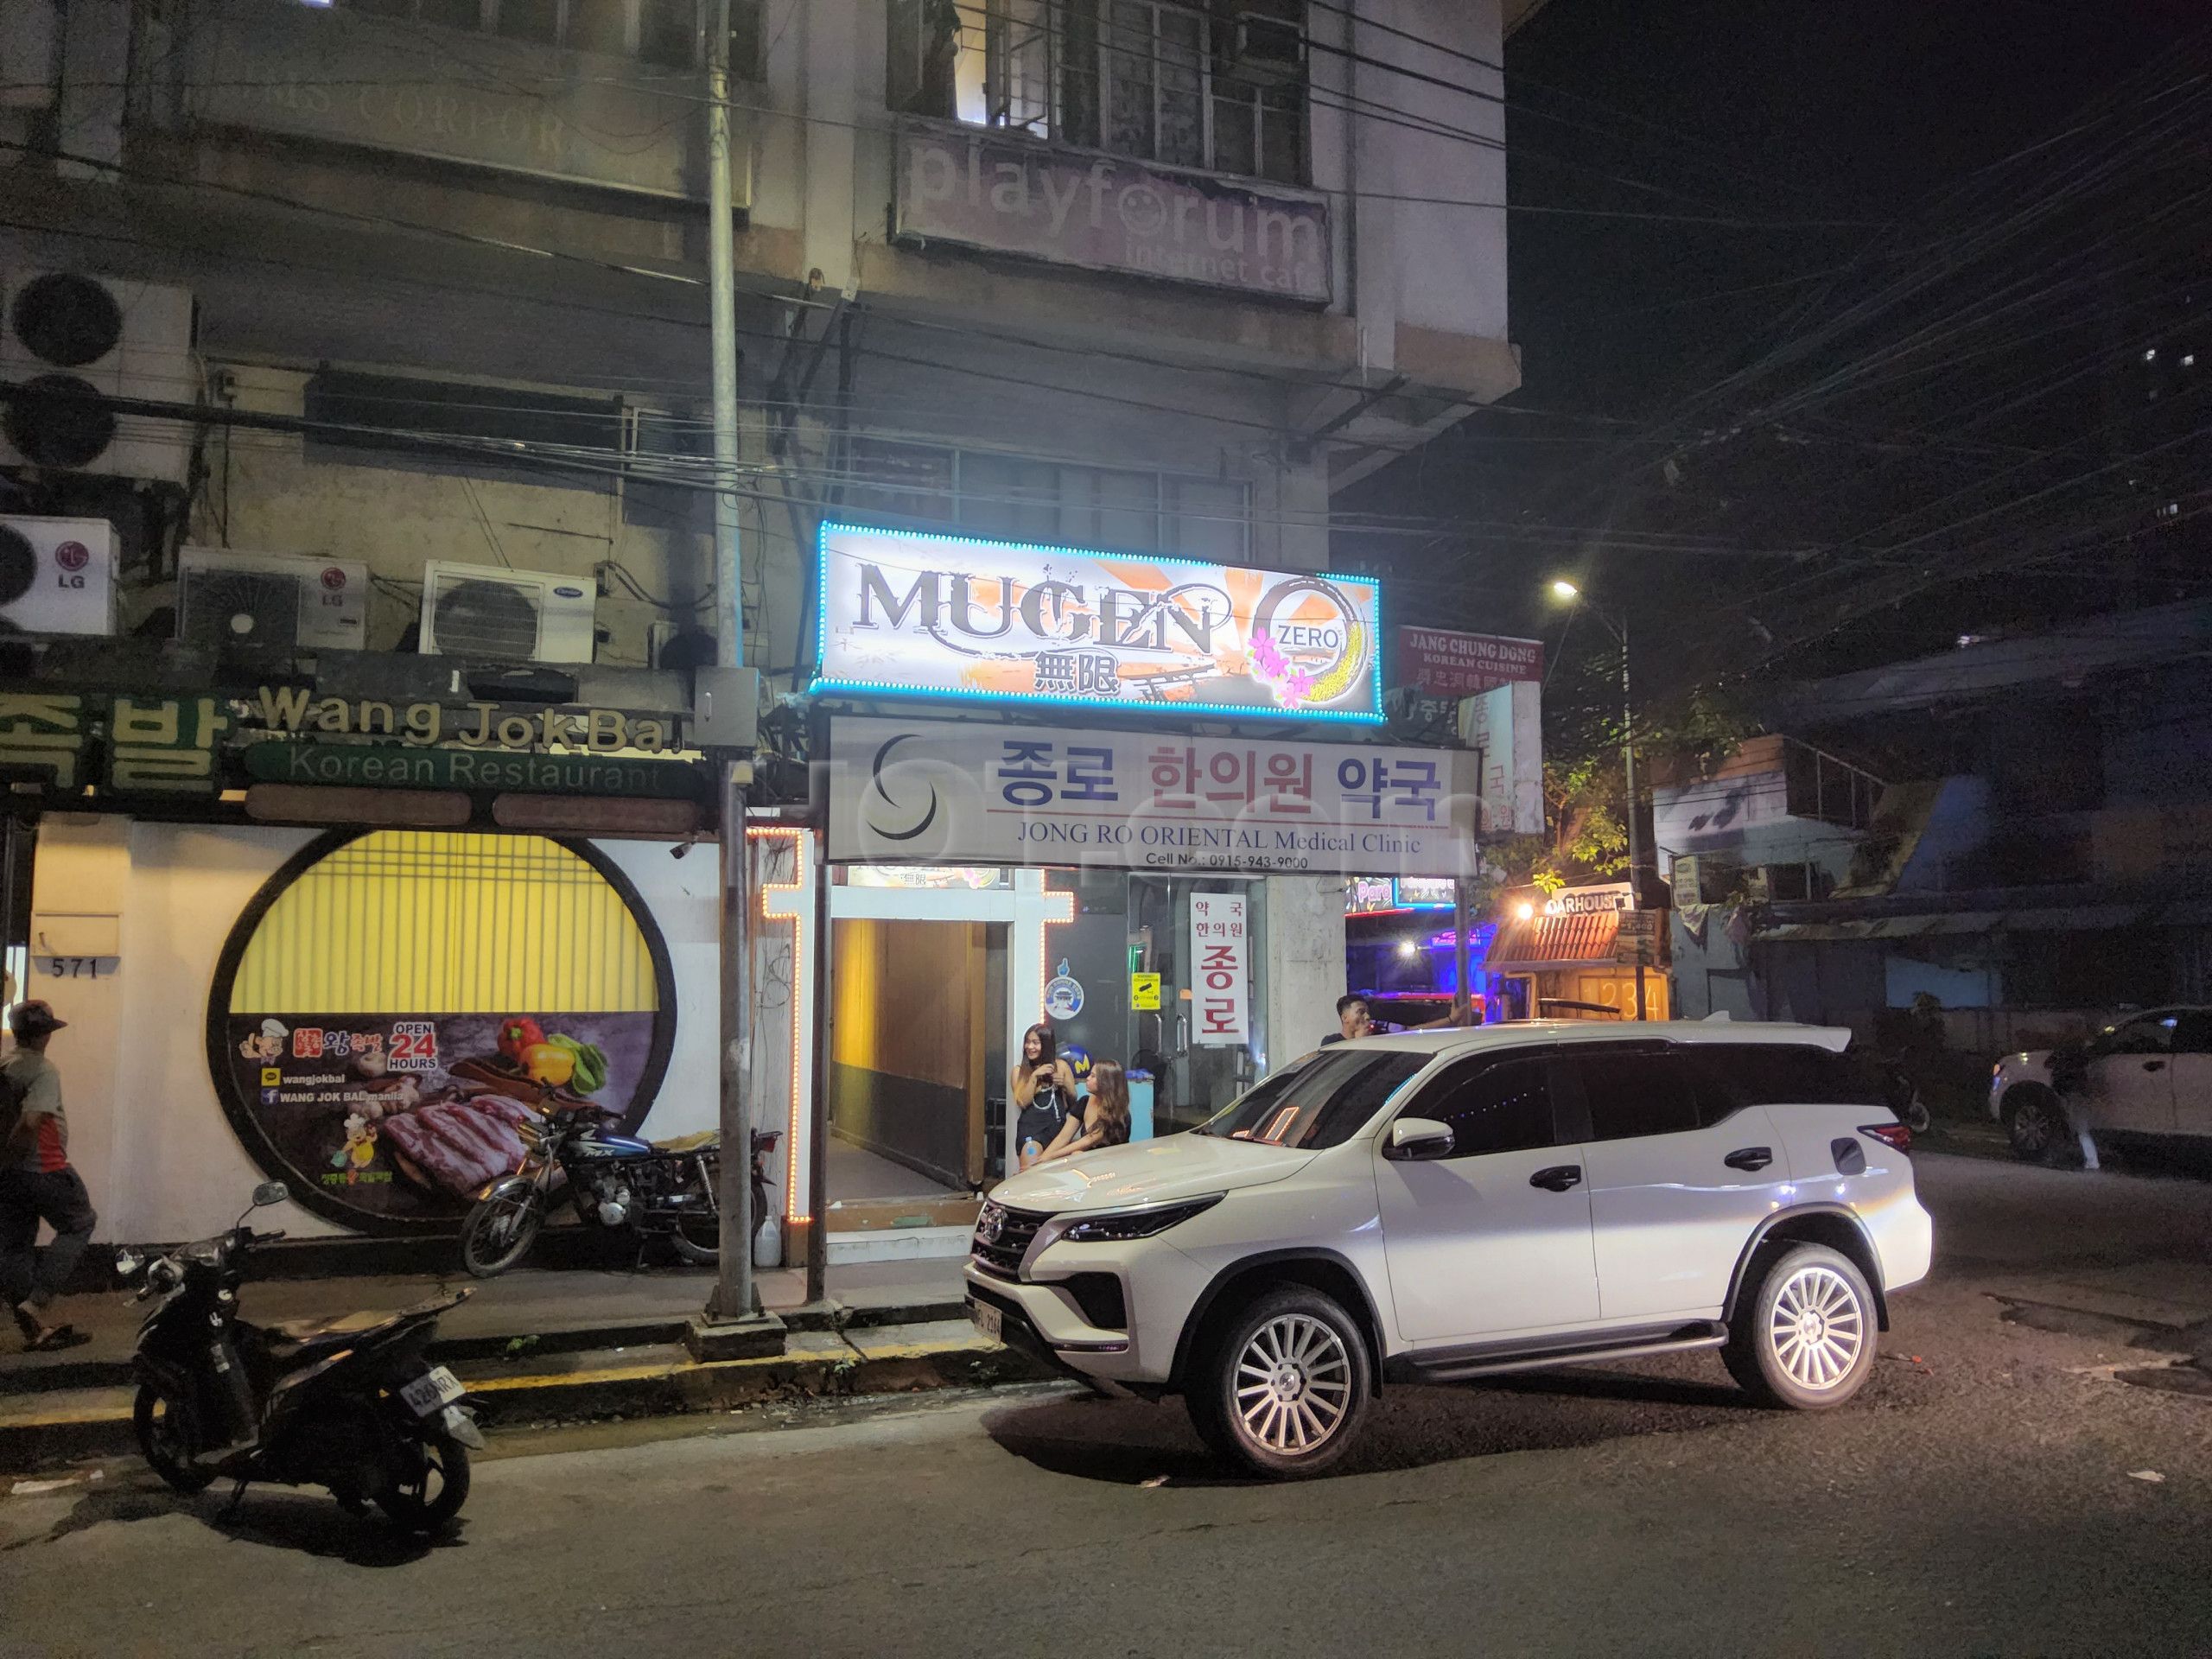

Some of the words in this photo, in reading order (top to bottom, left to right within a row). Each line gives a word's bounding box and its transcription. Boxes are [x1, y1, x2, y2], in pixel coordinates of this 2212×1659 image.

[1125, 234, 1247, 283] internet
[58, 574, 85, 589] LG
[322, 594, 343, 607] LG
[855, 562, 1233, 658] MUGEN
[1278, 624, 1340, 649] ZERO
[1409, 633, 1446, 652] JANG
[1450, 638, 1497, 659] CHUNG
[1499, 646, 1536, 664] DONG
[1033, 652, 1121, 694] 無限
[1424, 653, 1474, 671] KOREAN
[1478, 659, 1527, 675] CUISINE
[259, 685, 442, 745] Wang
[290, 745, 434, 780] Korean
[449, 753, 659, 788] Restaurant
[997, 741, 1119, 807] 종로
[1148, 747, 1313, 813] 한의원
[1338, 757, 1442, 821] 약국
[1018, 820, 1088, 844] JONG
[1097, 824, 1133, 845] RO
[1141, 825, 1268, 850] ORIENTAL
[1274, 830, 1355, 852] Medical
[1363, 833, 1421, 854] Clinic
[1146, 851, 1173, 865] Cell
[1210, 855, 1308, 869] 0915-943-9000
[1195, 901, 1210, 917] 약
[1230, 901, 1243, 918] 국
[1195, 922, 1243, 938] 한의원
[52, 957, 97, 980] 571
[1201, 944, 1239, 1034] 종로
[396, 1024, 432, 1034] OPEN
[390, 1034, 436, 1058] 24
[390, 1058, 436, 1070] HOURS
[280, 1092, 315, 1102] WANG
[317, 1092, 341, 1102] JOK
